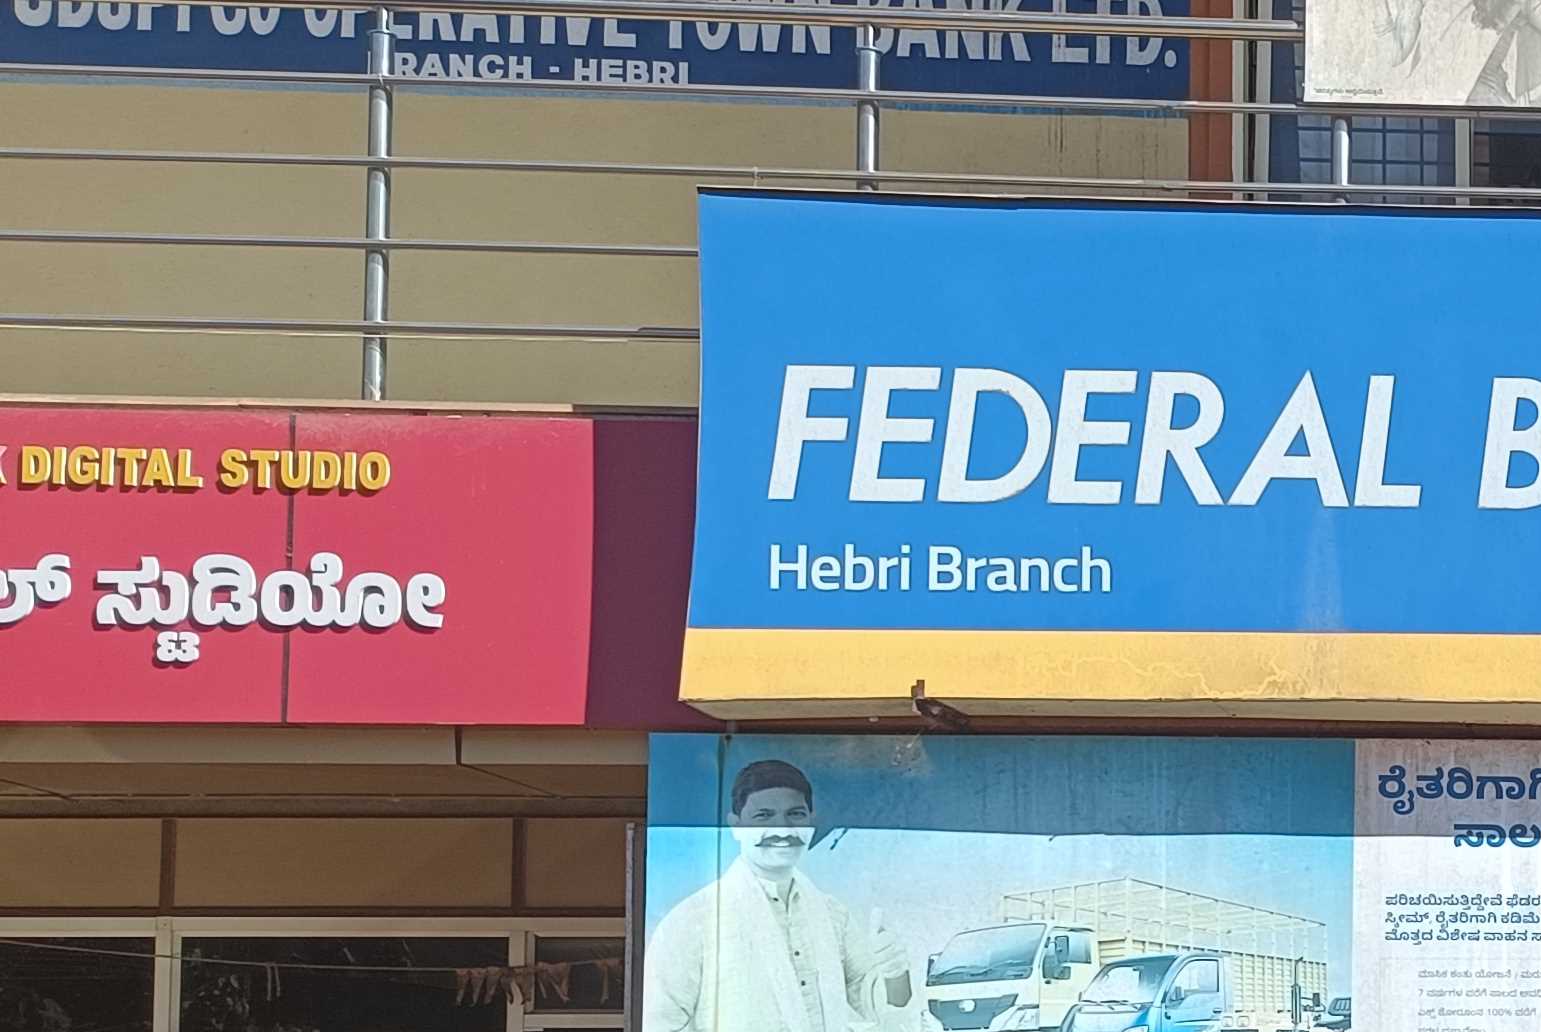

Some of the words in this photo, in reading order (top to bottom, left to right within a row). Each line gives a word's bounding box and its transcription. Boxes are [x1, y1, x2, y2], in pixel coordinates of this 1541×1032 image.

[368, 51, 532, 80] RANCH
[574, 58, 689, 84] HEBRI
[765, 365, 1423, 510] FEDERAL
[20, 446, 203, 489] DIGITAL
[220, 449, 391, 491] STUDIO
[769, 543, 912, 595] Hebri
[927, 543, 1112, 596] Branch
[95, 551, 447, 664] ಸ್ಟುಡಿಯೋ
[1435, 912, 1497, 930] ರೈತರಿಗಾಗಿ
[1500, 913, 1540, 925] ಕಡಿಮೆ
[1483, 930, 1528, 942] ವಾಹನ
